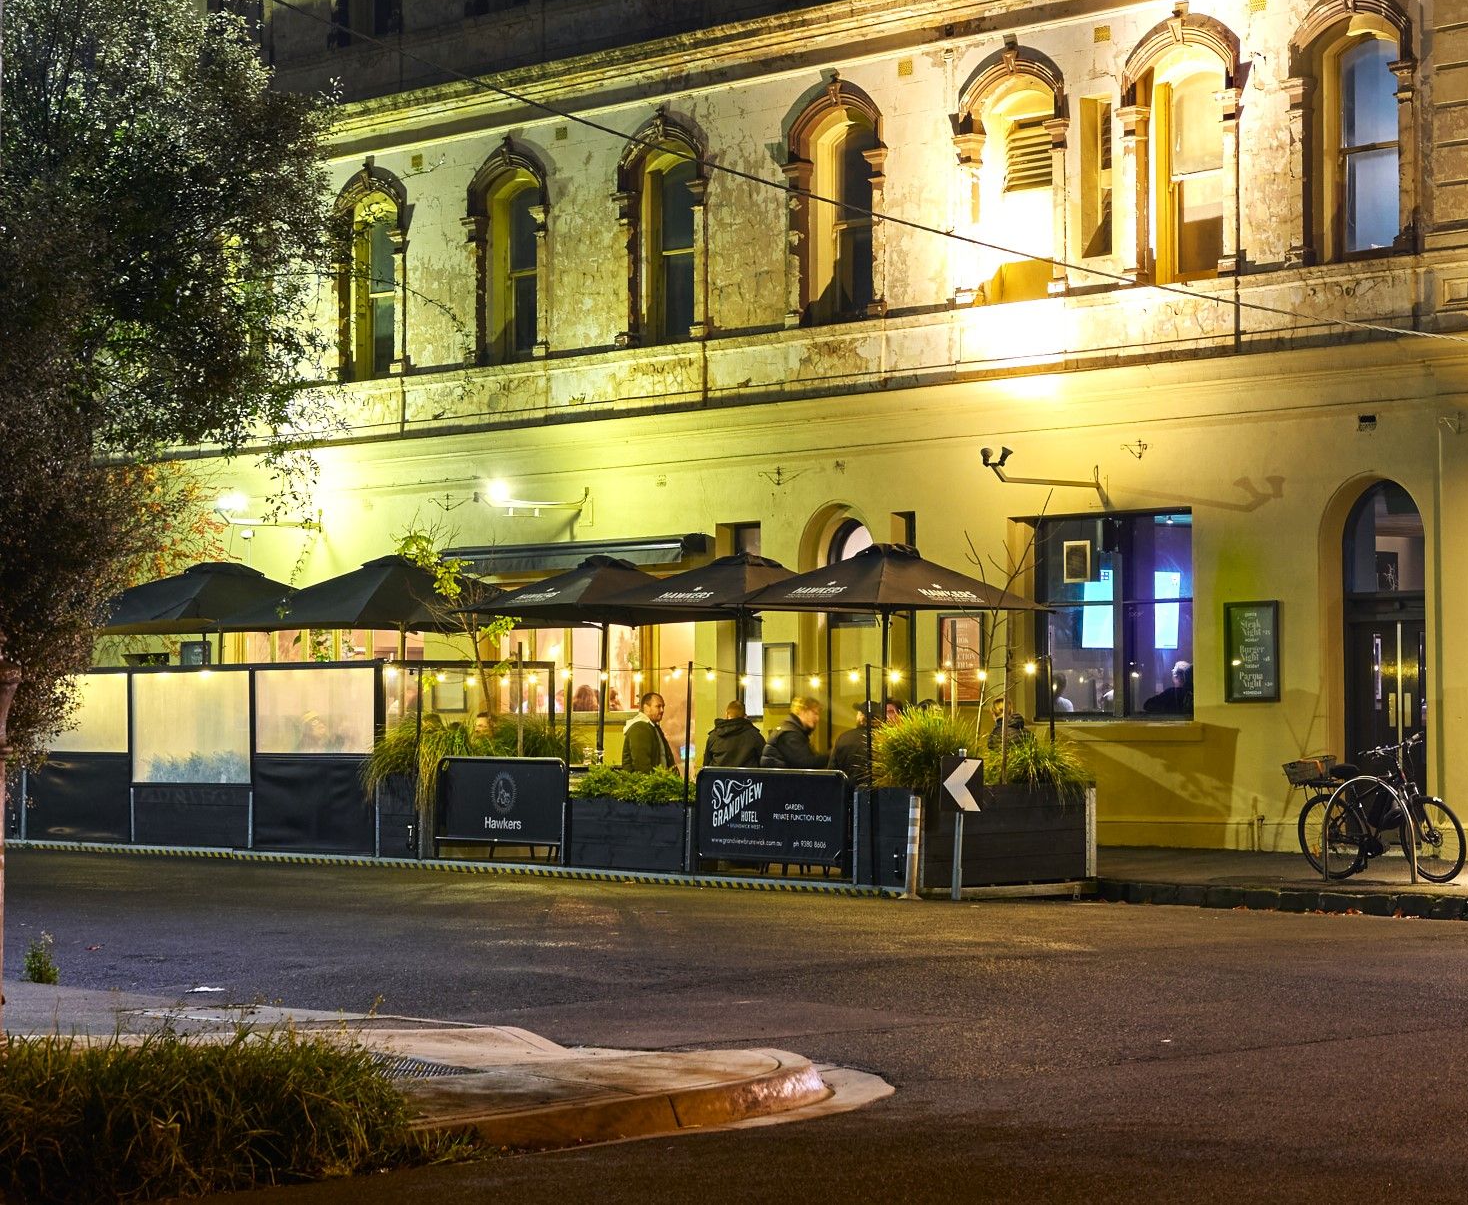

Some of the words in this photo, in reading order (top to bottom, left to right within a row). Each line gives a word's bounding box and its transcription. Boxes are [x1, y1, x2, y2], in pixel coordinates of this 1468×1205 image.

[792, 586, 848, 594] HAWKERS
[917, 588, 978, 598] HAWKERS
[712, 782, 763, 827] GRANDVIEW
[785, 803, 804, 811] GARDEN
[741, 810, 759, 823] HOTEL
[773, 813, 790, 821] PRIVATE
[790, 814, 815, 822] FUNCTION
[484, 816, 522, 830] Hawkers
